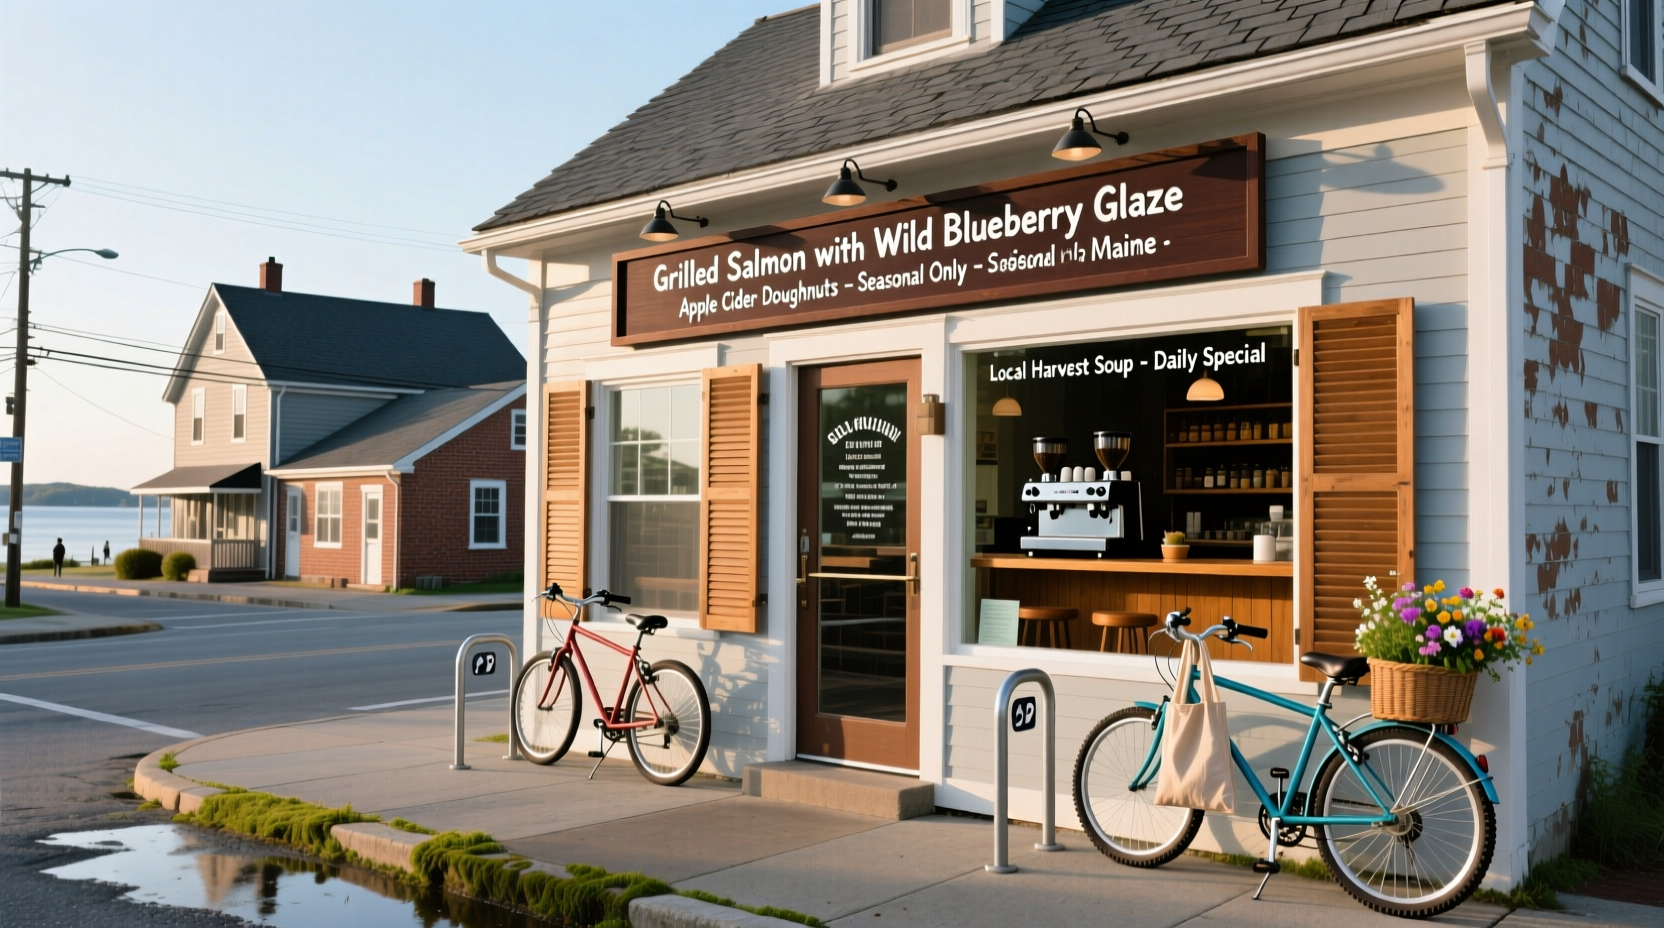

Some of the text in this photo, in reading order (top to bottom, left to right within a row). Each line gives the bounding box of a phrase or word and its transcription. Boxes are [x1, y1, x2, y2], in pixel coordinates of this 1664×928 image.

[653, 182, 1184, 292] Grilled Salmon with Wild Blueberry Glaze
[678, 294, 718, 324] Apple
[721, 287, 758, 312] Cider
[762, 278, 839, 309] Doughnuts
[857, 262, 924, 292] Seasonal
[929, 256, 968, 288] Only
[1091, 234, 1157, 262] Maine
[989, 360, 1027, 382] Local
[1031, 358, 1090, 379] Harvest
[1094, 354, 1134, 378] Soup
[1154, 347, 1199, 374] Daily
[1202, 341, 1267, 371] Special
